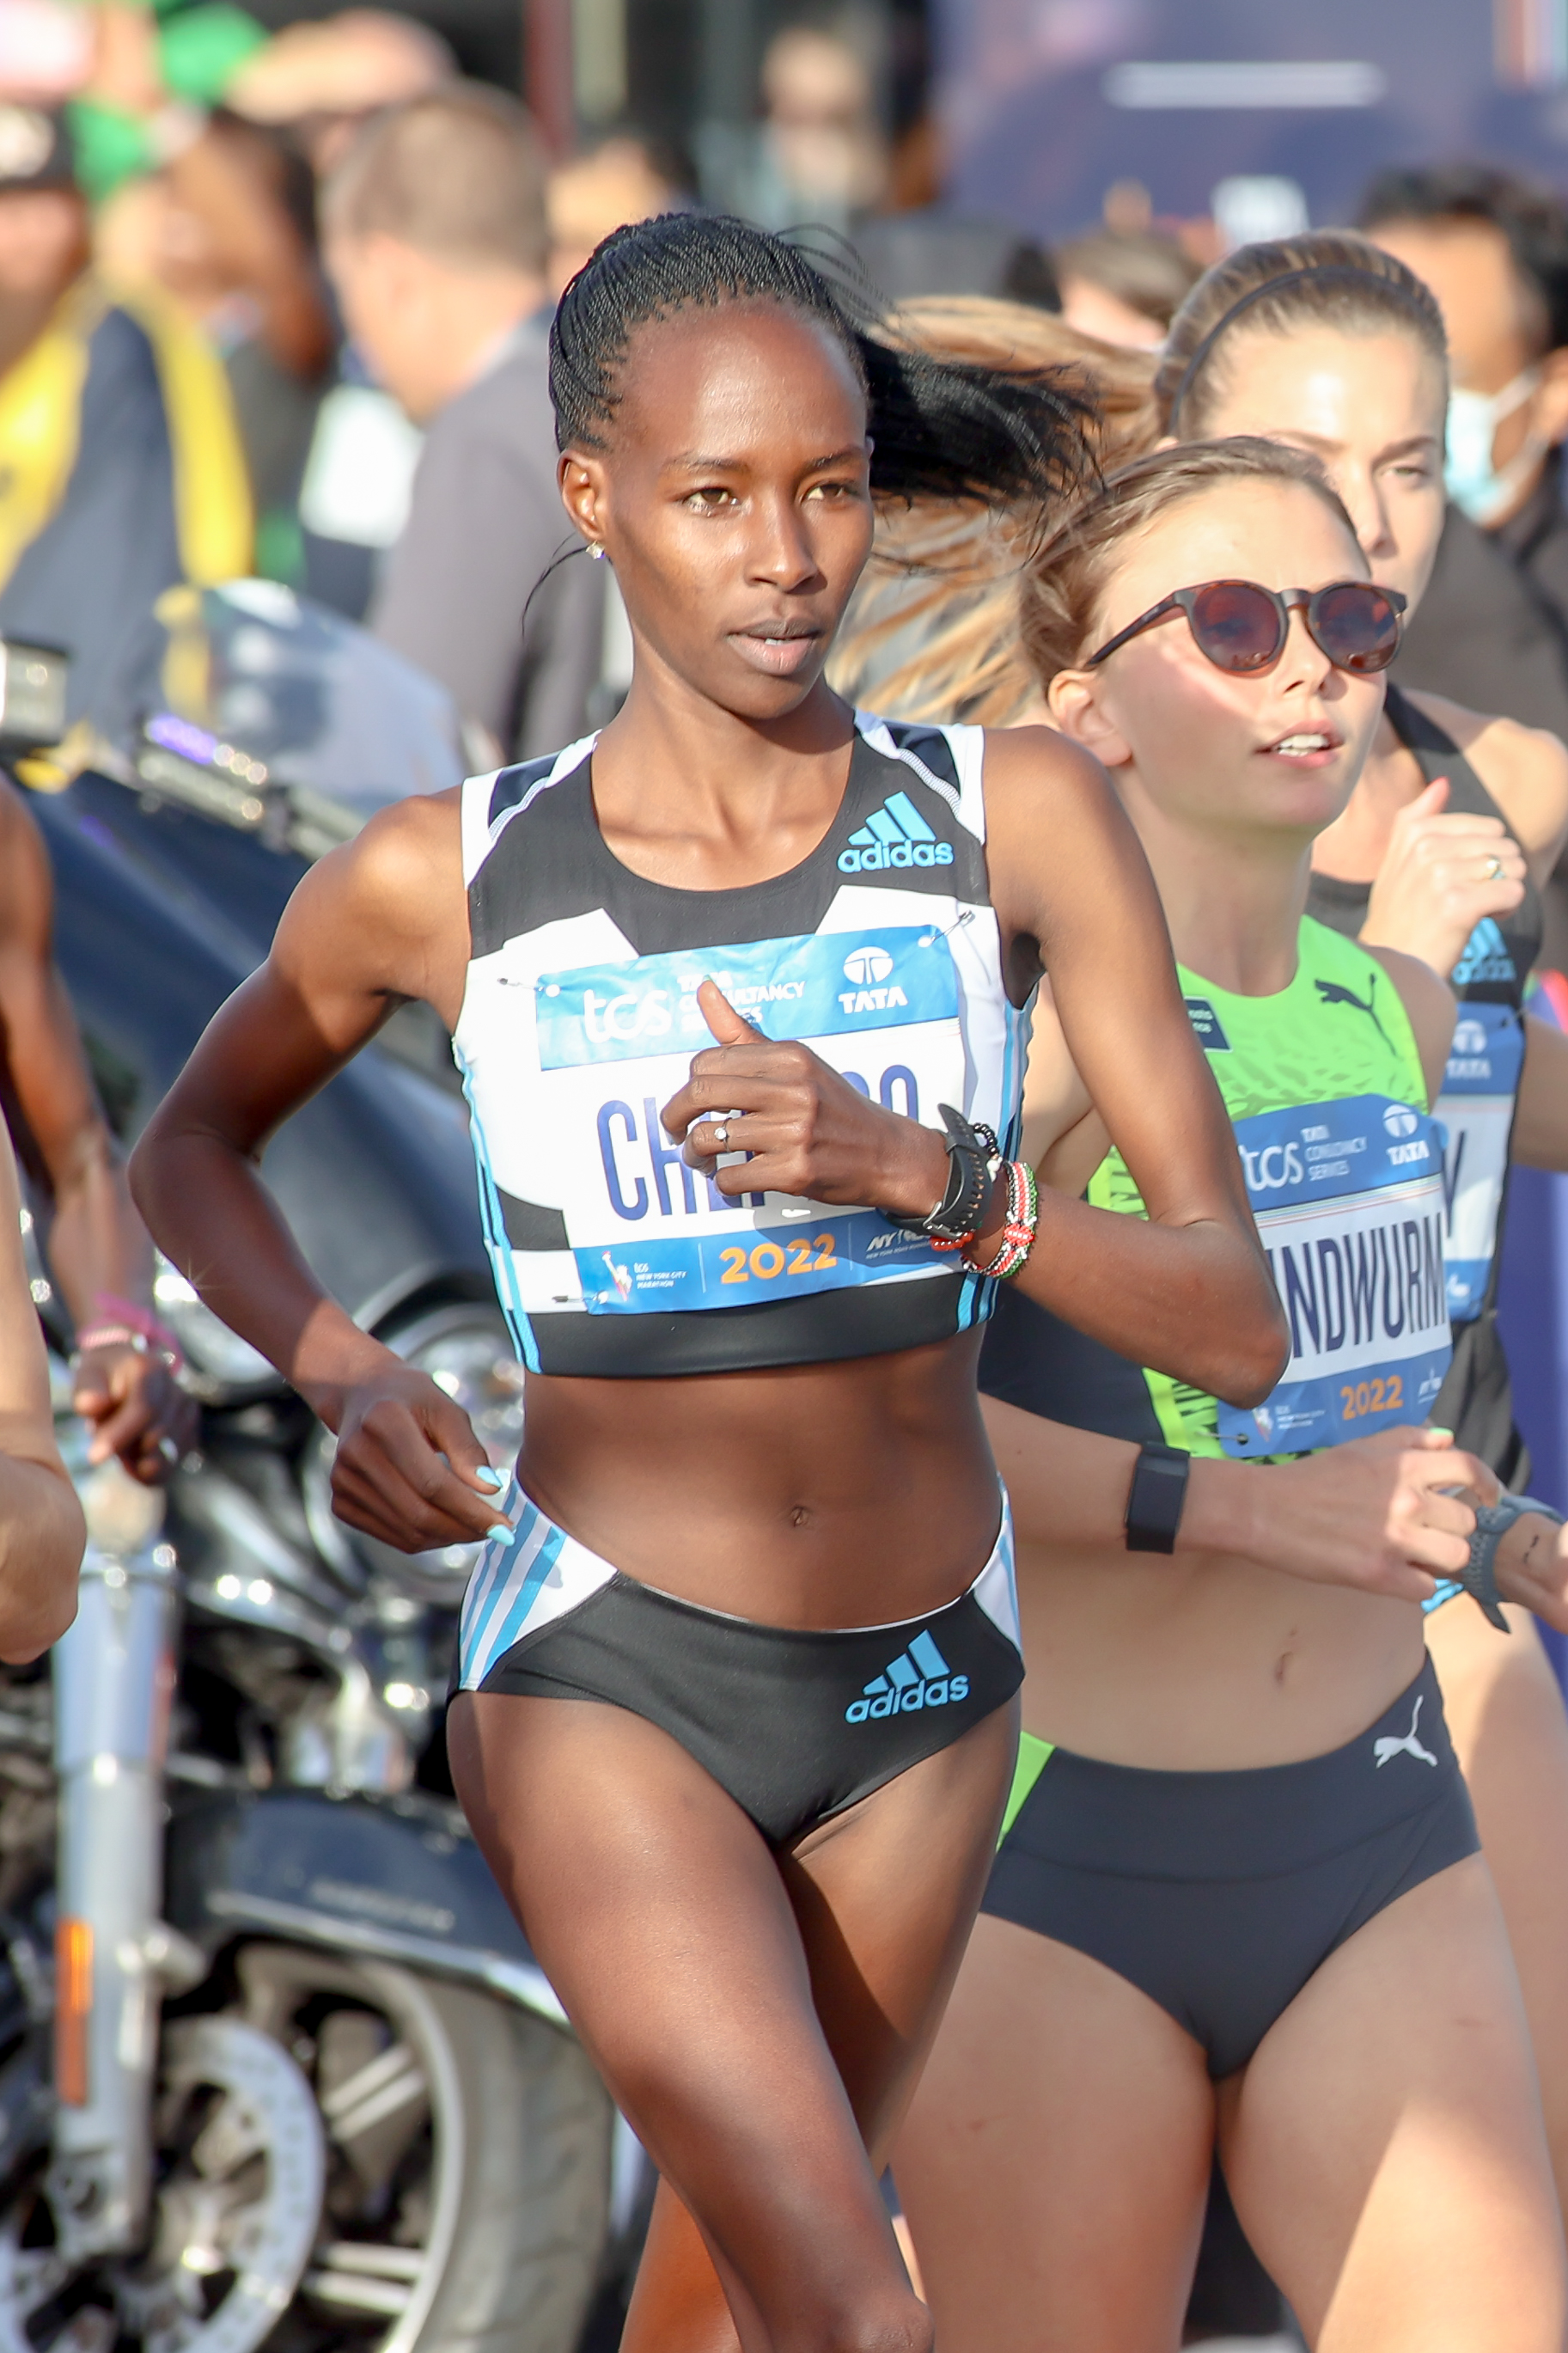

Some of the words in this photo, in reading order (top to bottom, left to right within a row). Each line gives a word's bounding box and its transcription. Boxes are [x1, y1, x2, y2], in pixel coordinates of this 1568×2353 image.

[838, 840, 955, 873] adidas
[583, 988, 673, 1044] tcs
[839, 986, 908, 1014] TATA
[1237, 1141, 1304, 1191] tcs
[1386, 1140, 1431, 1166] TATA
[718, 1233, 837, 1284] 2022
[1339, 1375, 1403, 1421] 2022
[845, 1675, 970, 1724] adidas
